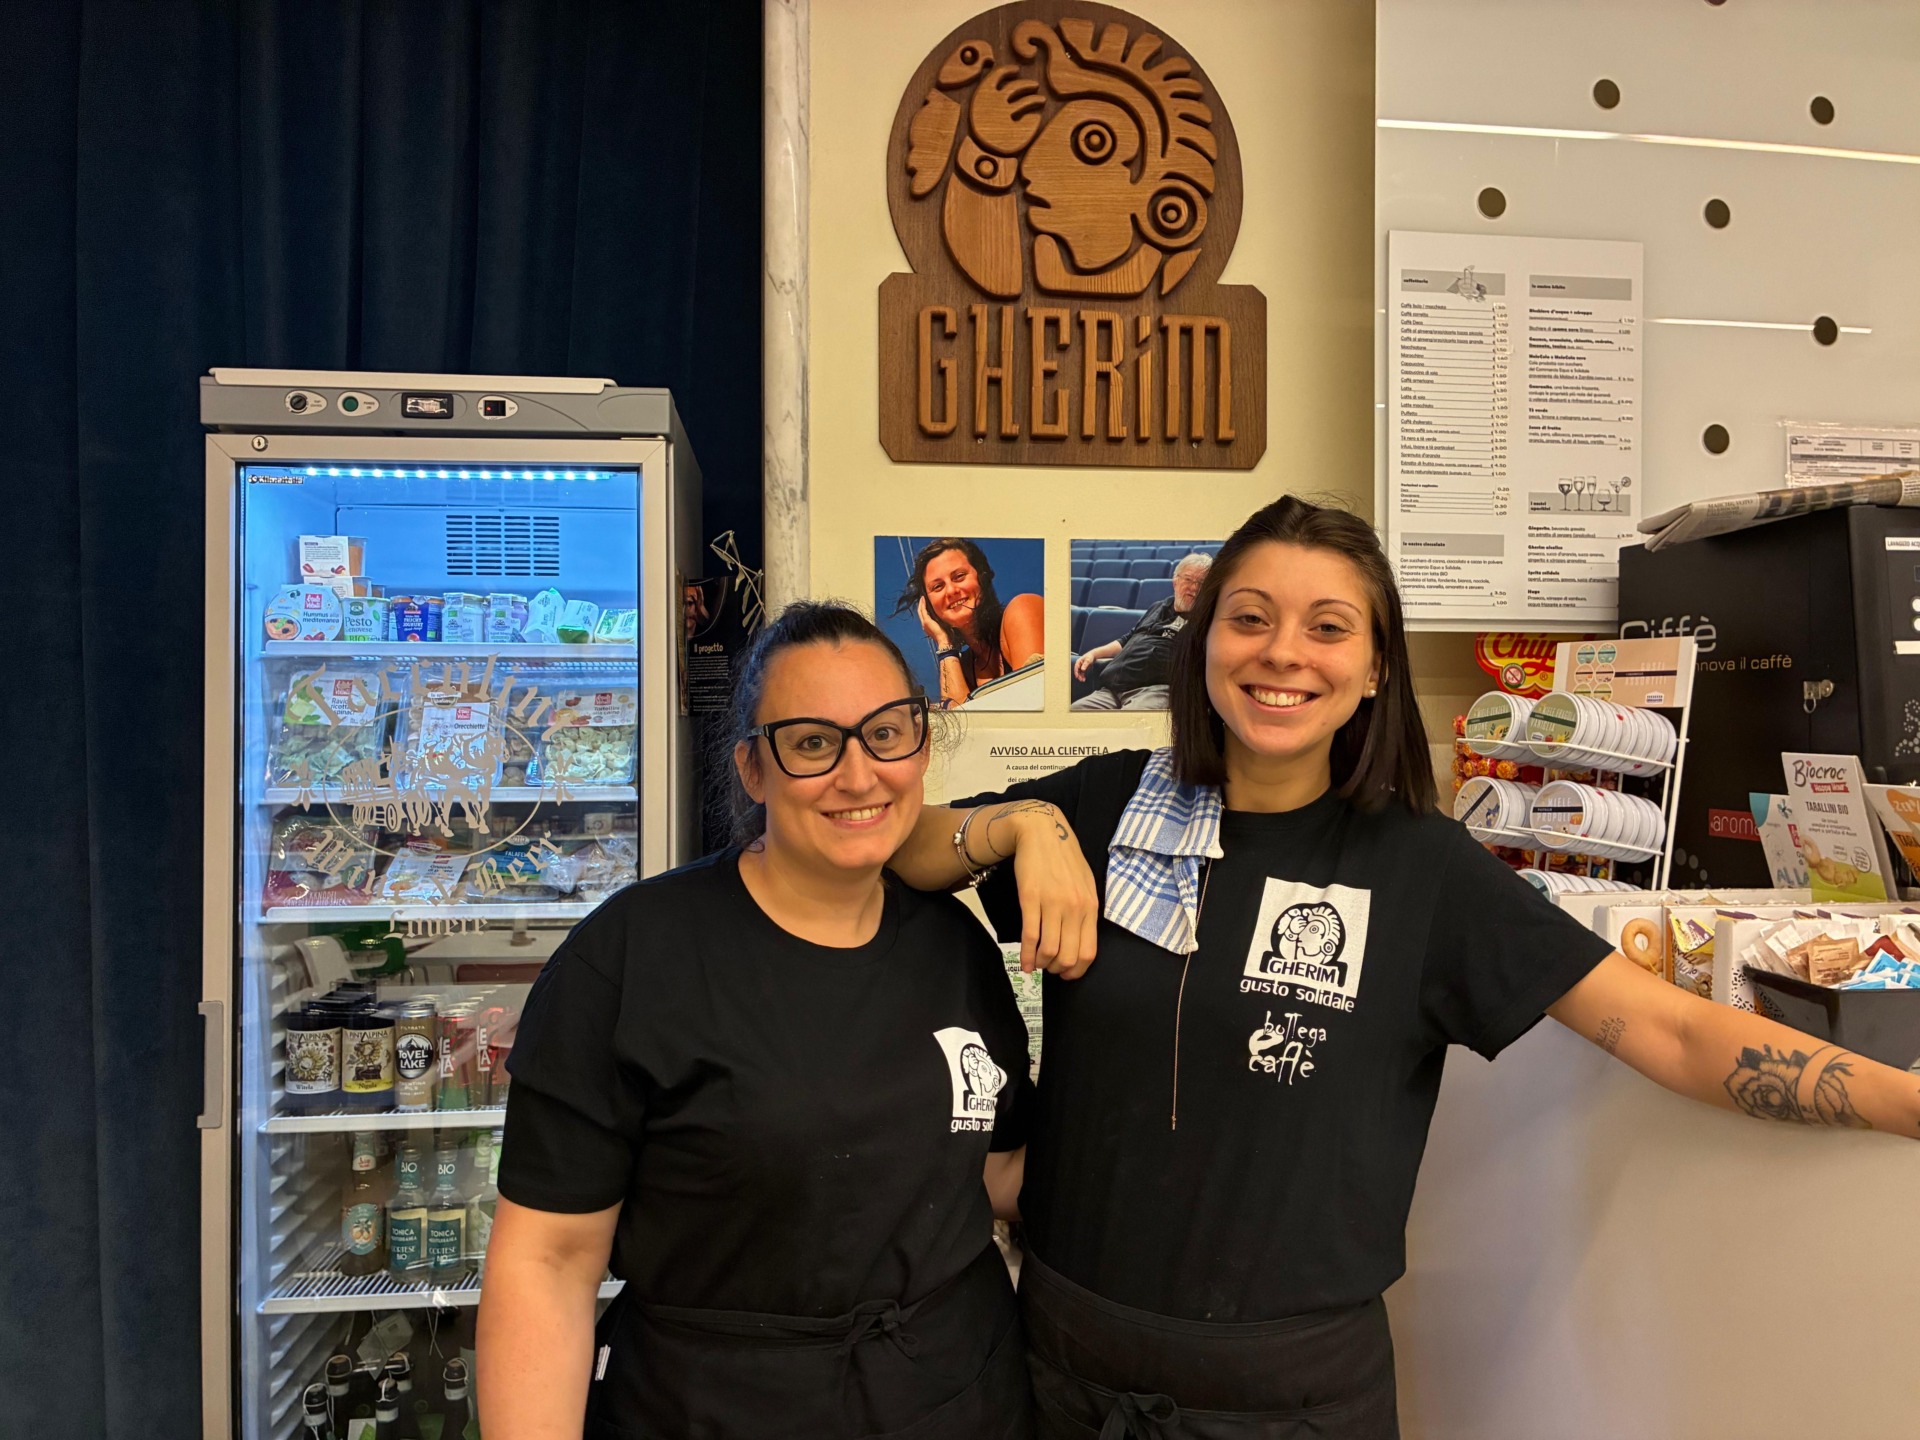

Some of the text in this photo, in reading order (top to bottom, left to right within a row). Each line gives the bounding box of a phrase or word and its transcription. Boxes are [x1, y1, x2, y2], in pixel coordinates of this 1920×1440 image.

[345, 616, 373, 627] Pesto
[698, 643, 724, 655] progetto
[1740, 657, 1747, 670] il
[1750, 655, 1792, 670] caffè
[453, 722, 486, 730] Orecchiette
[990, 746, 1109, 756] AVVISO ALLA CLIENTELA
[1792, 760, 1846, 787] Biocroc
[1805, 801, 1850, 815] TARALLINI BIO
[383, 910, 488, 940] Lovere
[1269, 959, 1337, 985] GHERIM
[1239, 977, 1355, 1013] gusto solidale
[400, 1059, 426, 1069] LAKE
[950, 1118, 981, 1133] gusto
[438, 1164, 456, 1175] BIO
[392, 1228, 415, 1236] TONICA
[430, 1230, 455, 1238] TONICA
